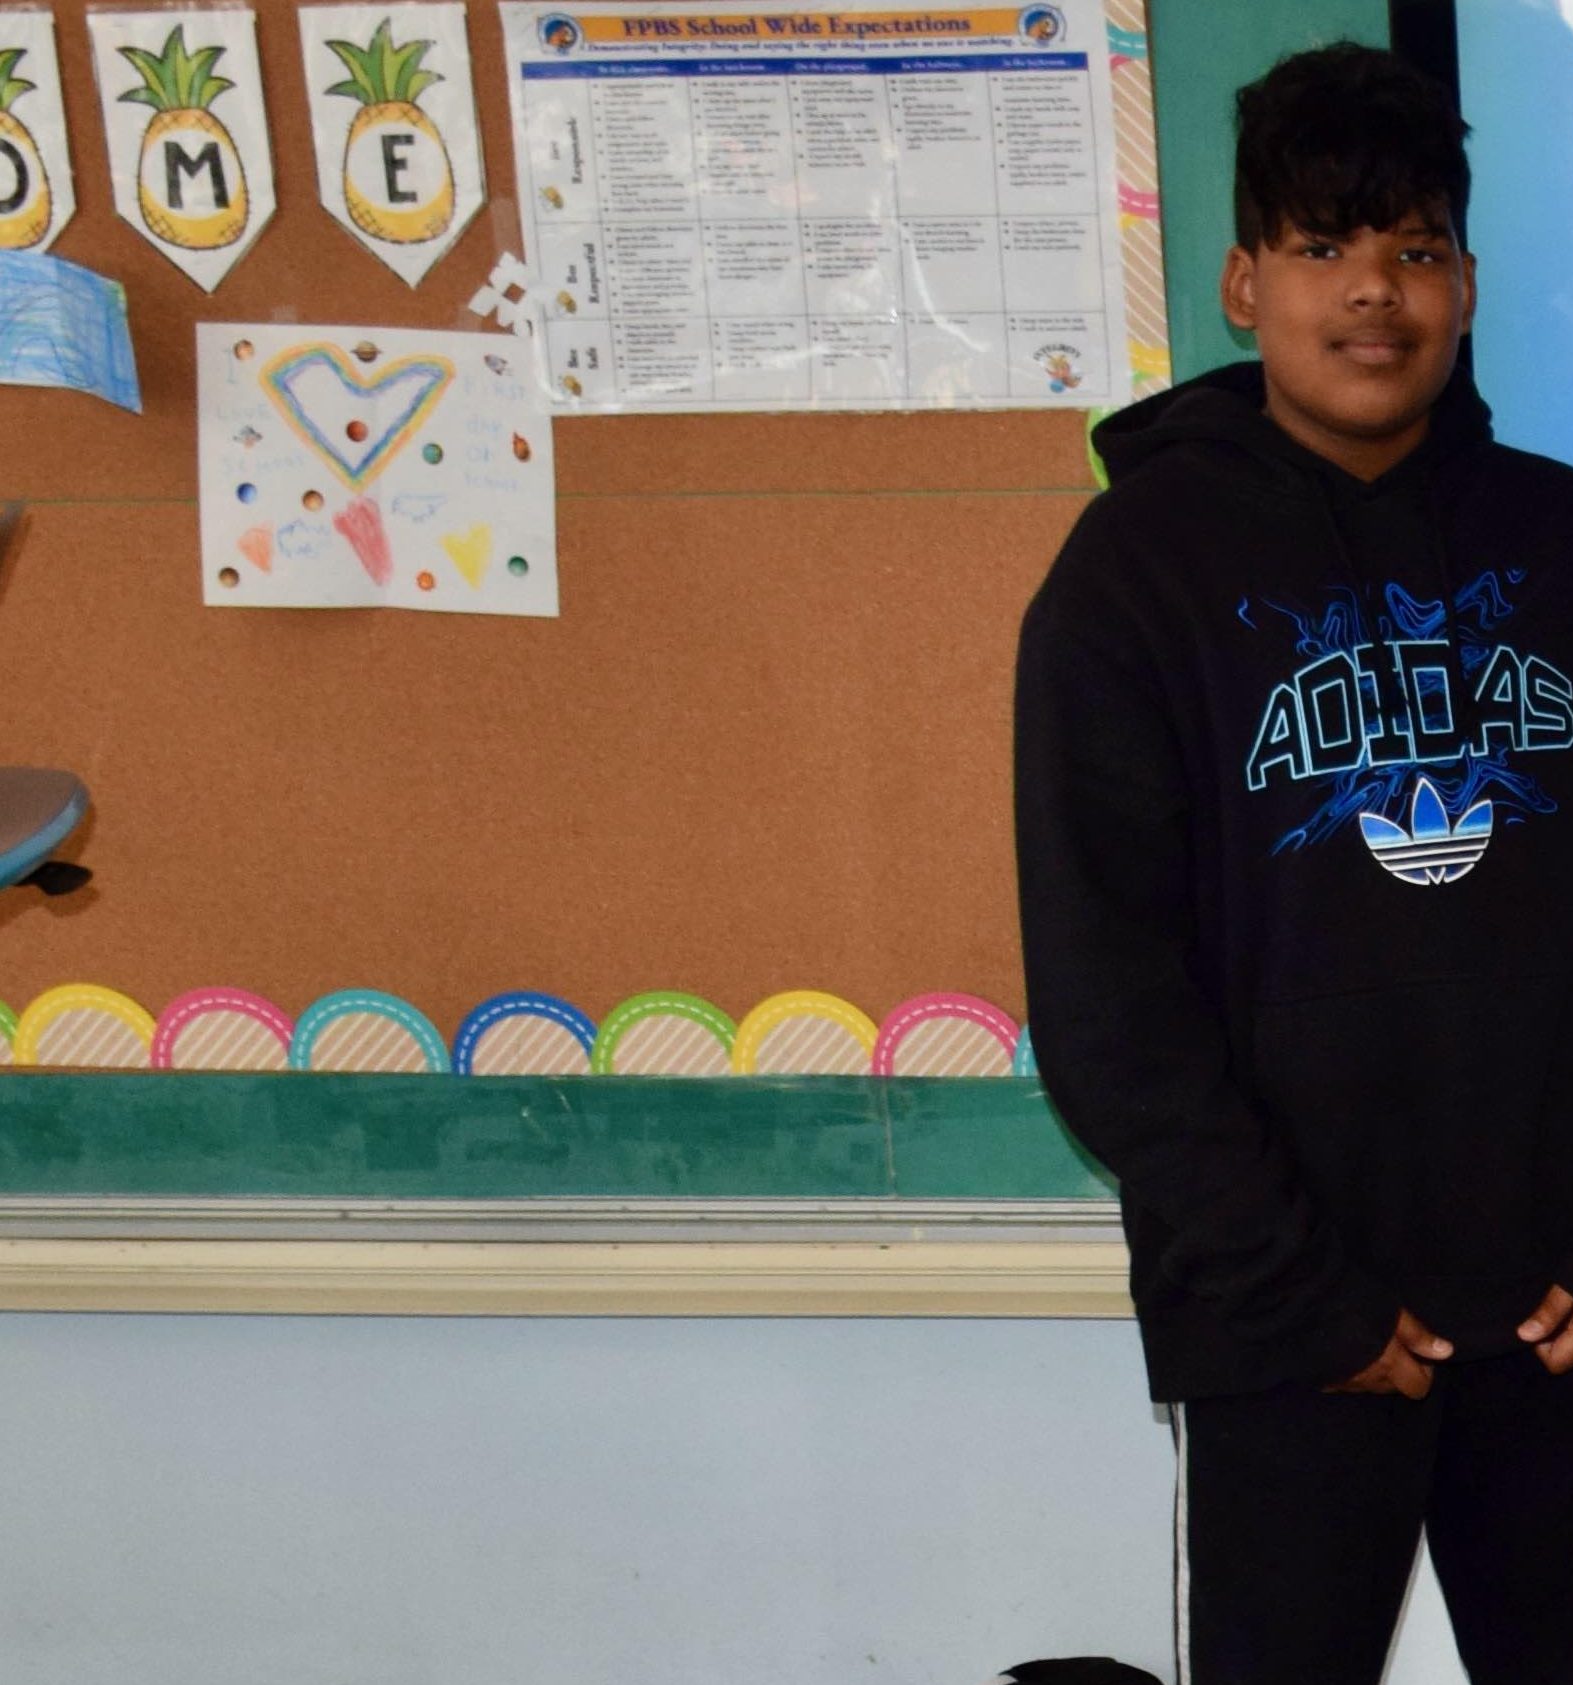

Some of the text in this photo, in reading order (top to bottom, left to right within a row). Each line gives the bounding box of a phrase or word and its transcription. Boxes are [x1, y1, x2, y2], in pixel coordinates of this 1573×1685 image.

[687, 17, 757, 35] School
[763, 16, 822, 34] Wide
[828, 15, 971, 40] Expectations
